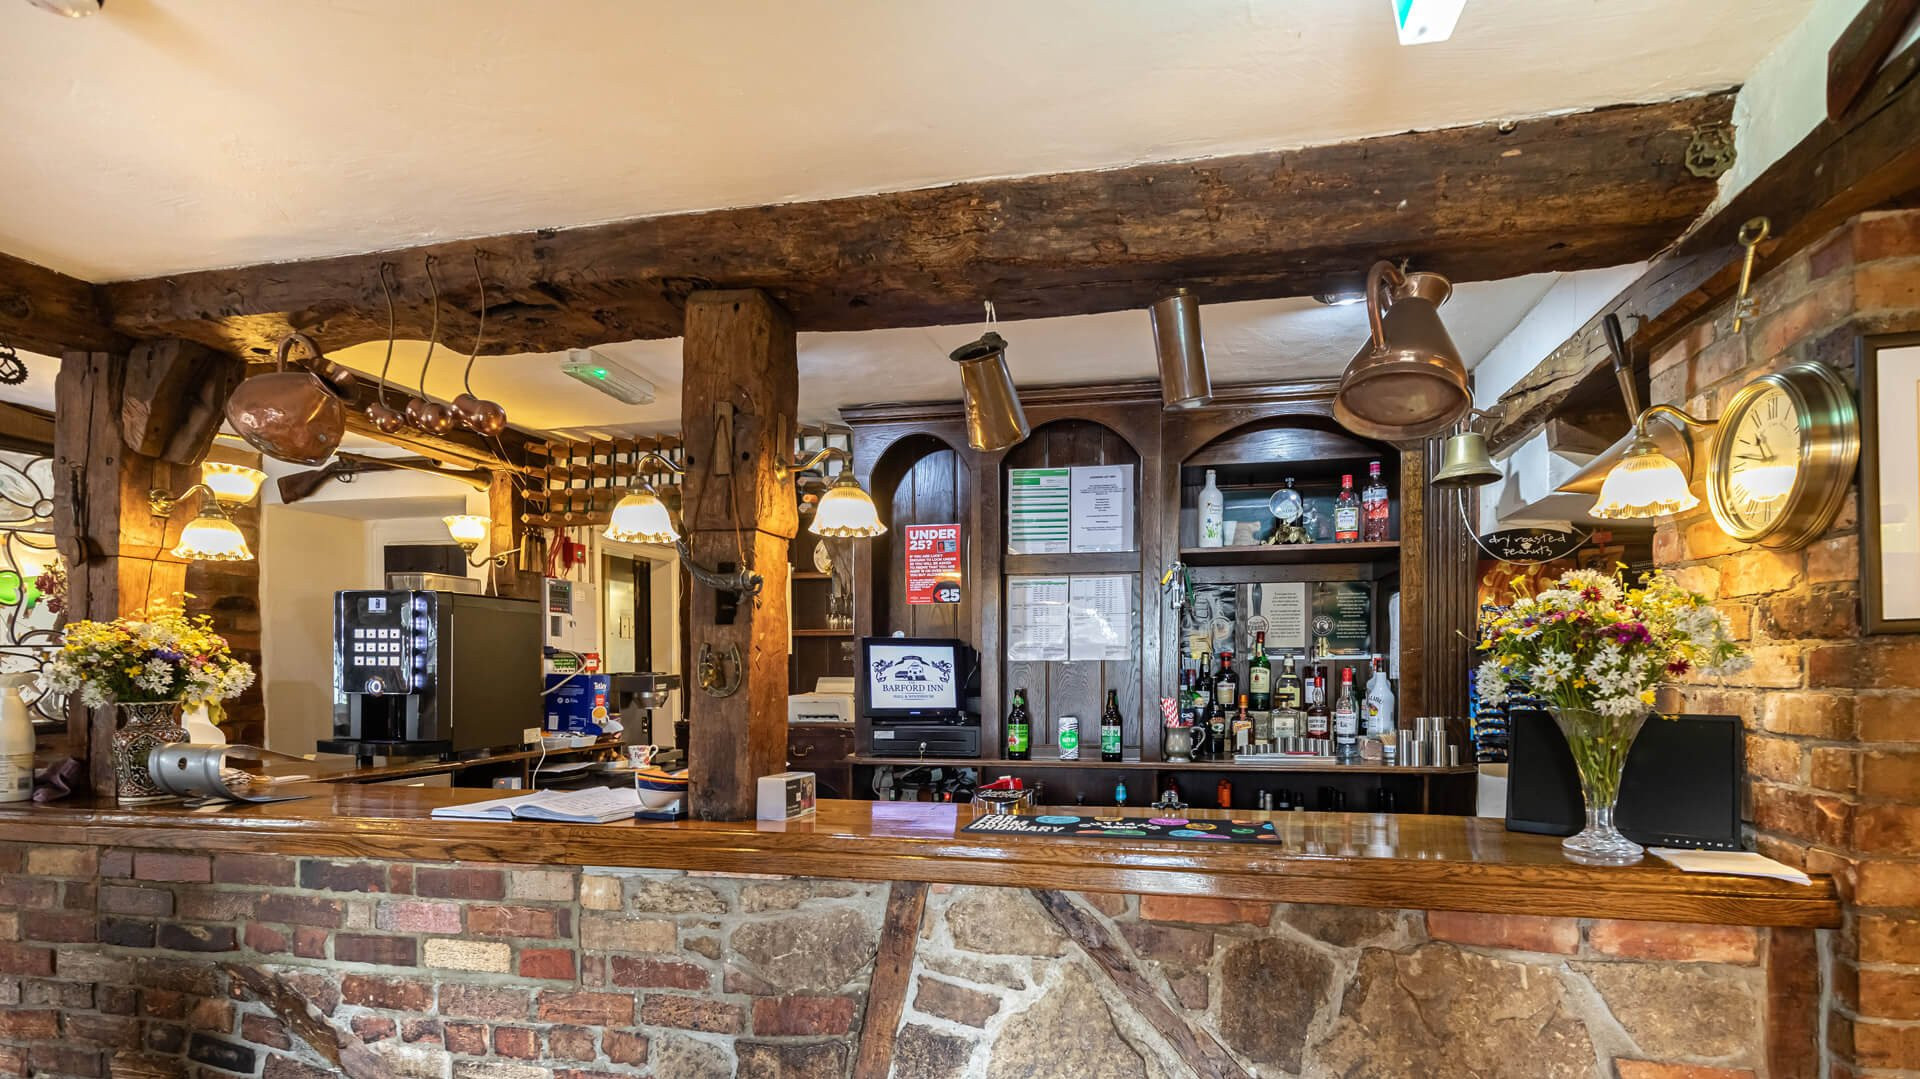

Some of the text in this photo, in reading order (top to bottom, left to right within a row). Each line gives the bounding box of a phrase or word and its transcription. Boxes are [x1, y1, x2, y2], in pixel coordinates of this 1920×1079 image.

[909, 528, 956, 540] UNDER
[909, 540, 933, 551] 25?
[1488, 533, 1567, 548] dry roasted
[941, 588, 960, 602] 25
[882, 684, 944, 692] BARFORD INN
[968, 823, 1065, 832] ORDINARY
